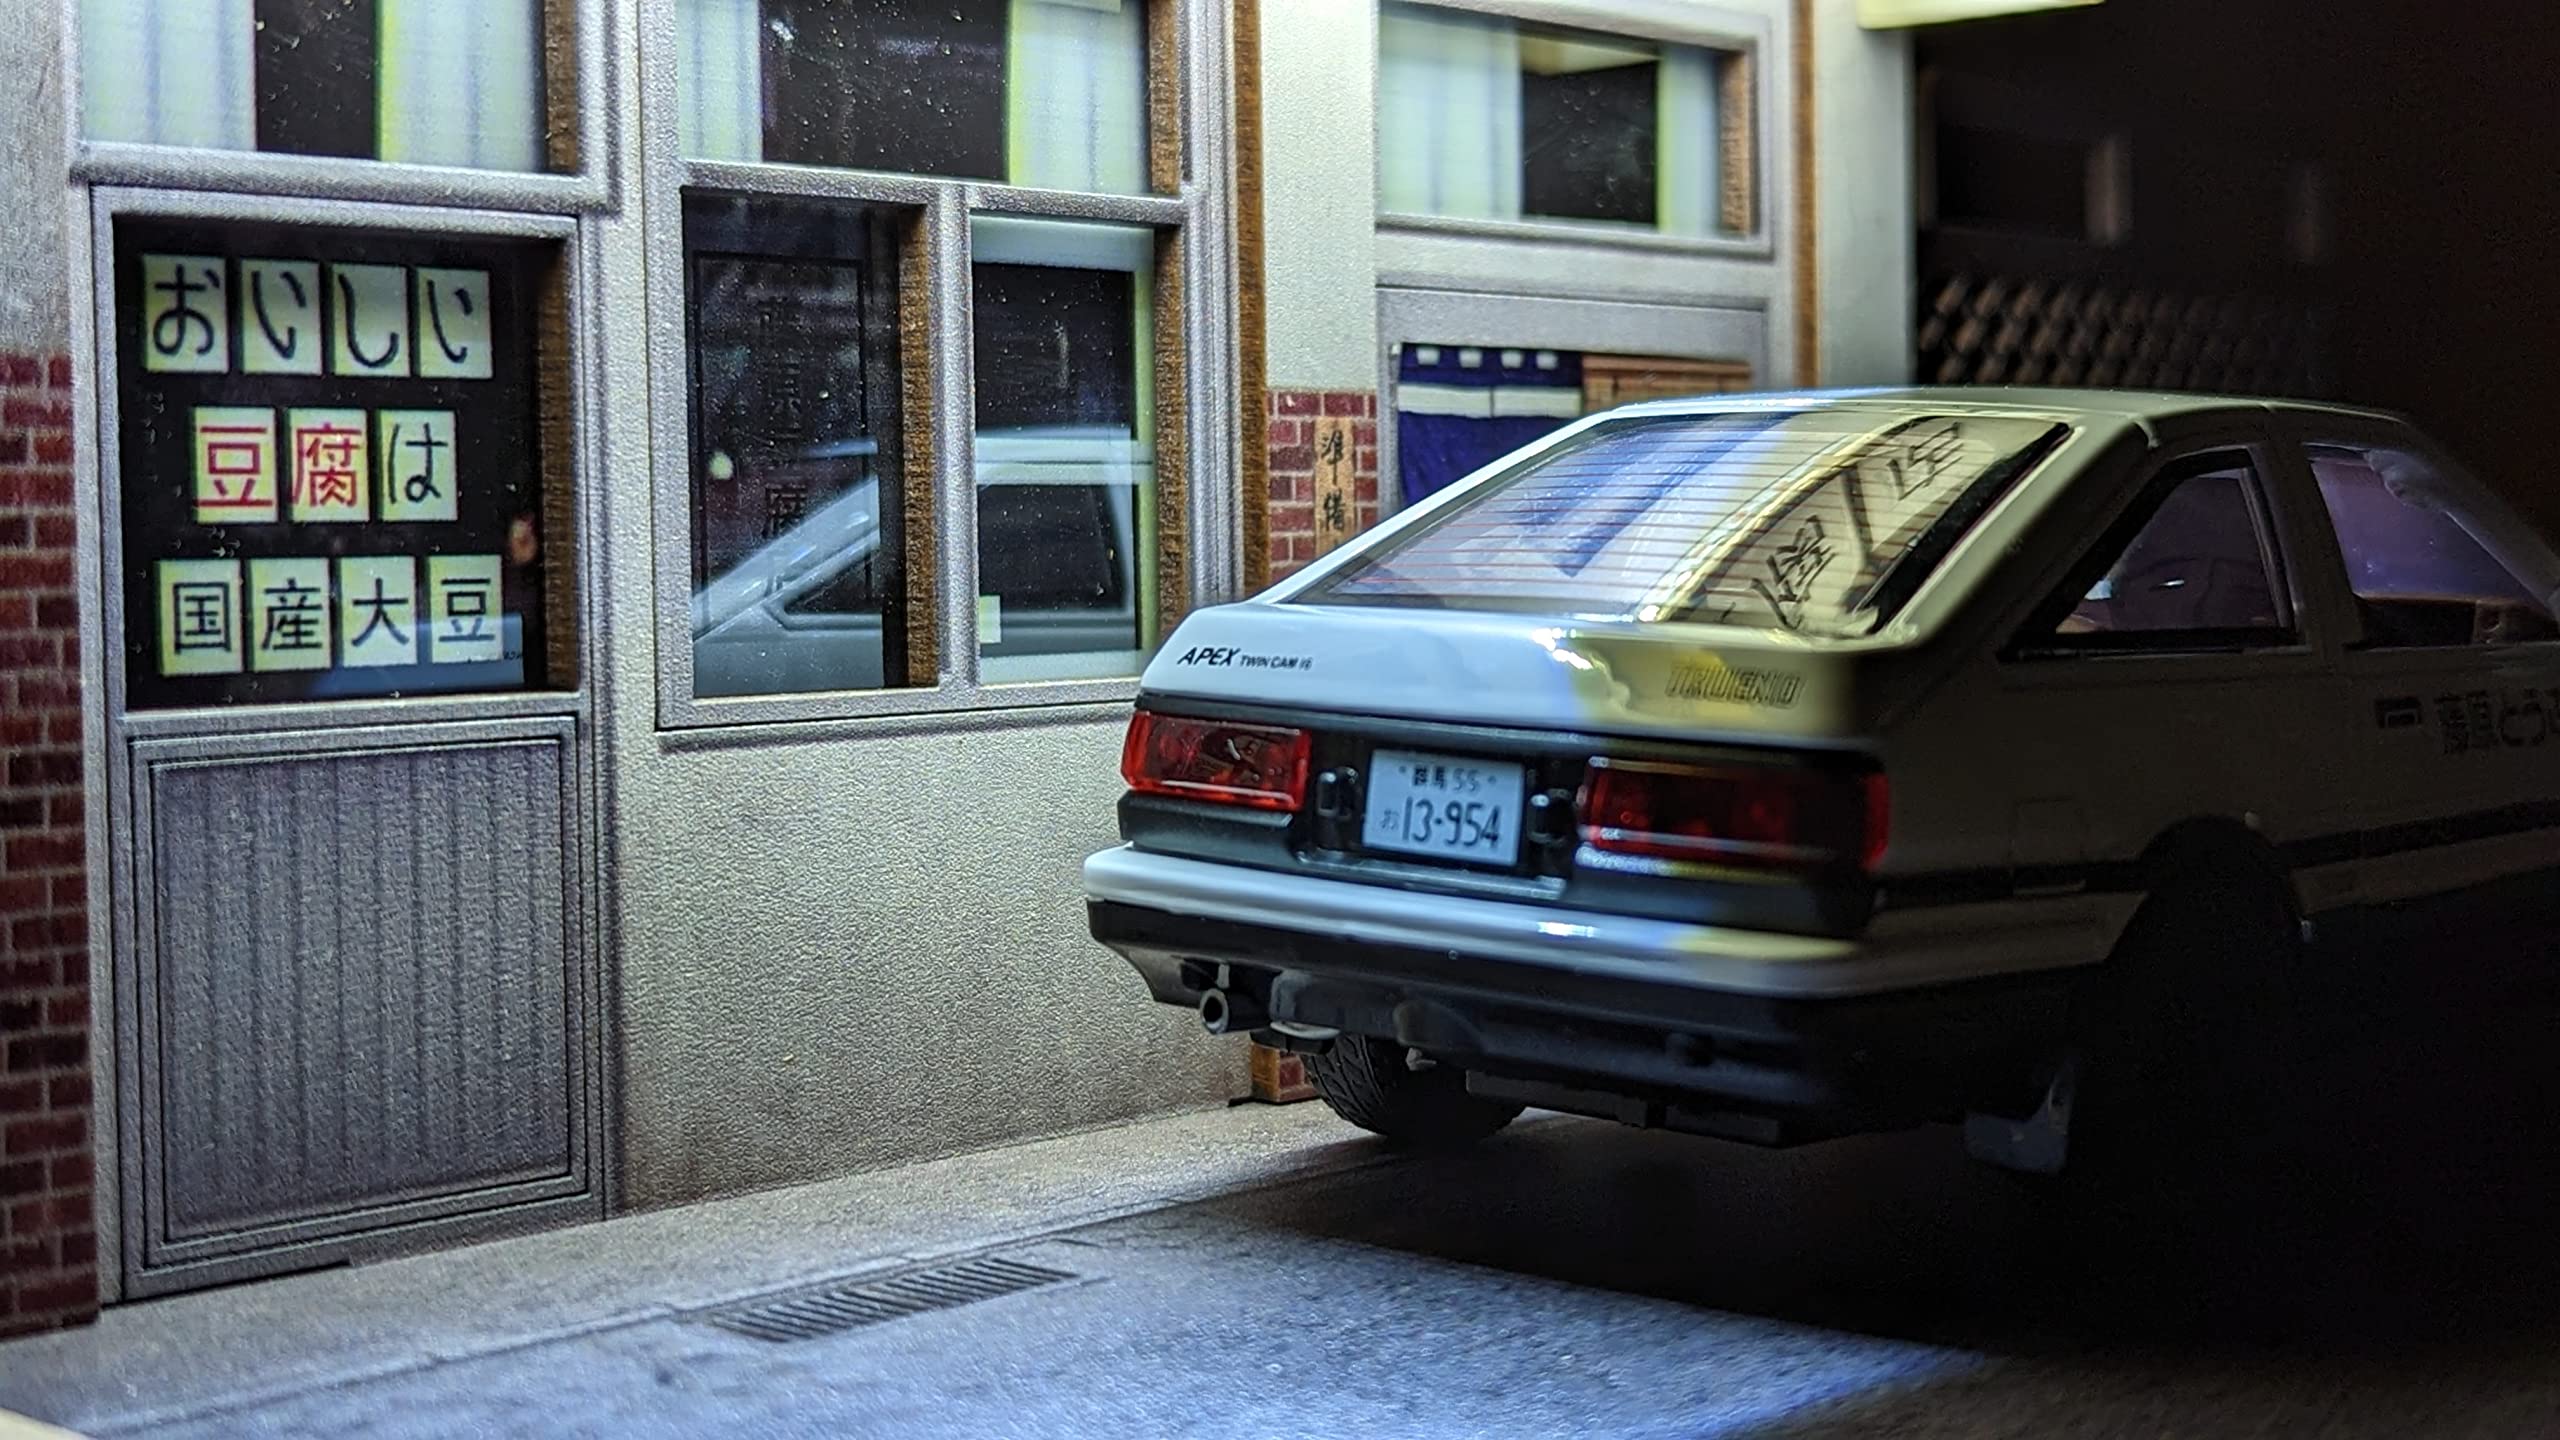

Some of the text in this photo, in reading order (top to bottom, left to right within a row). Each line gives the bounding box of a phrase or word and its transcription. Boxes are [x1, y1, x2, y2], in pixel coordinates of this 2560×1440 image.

[153, 263, 473, 368] おいしい
[199, 422, 449, 508] 豆腐は
[173, 577, 496, 655] 国産大豆
[1176, 646, 1242, 667] APEX
[1240, 654, 1272, 668] TWIN
[1270, 655, 1298, 670] CAM
